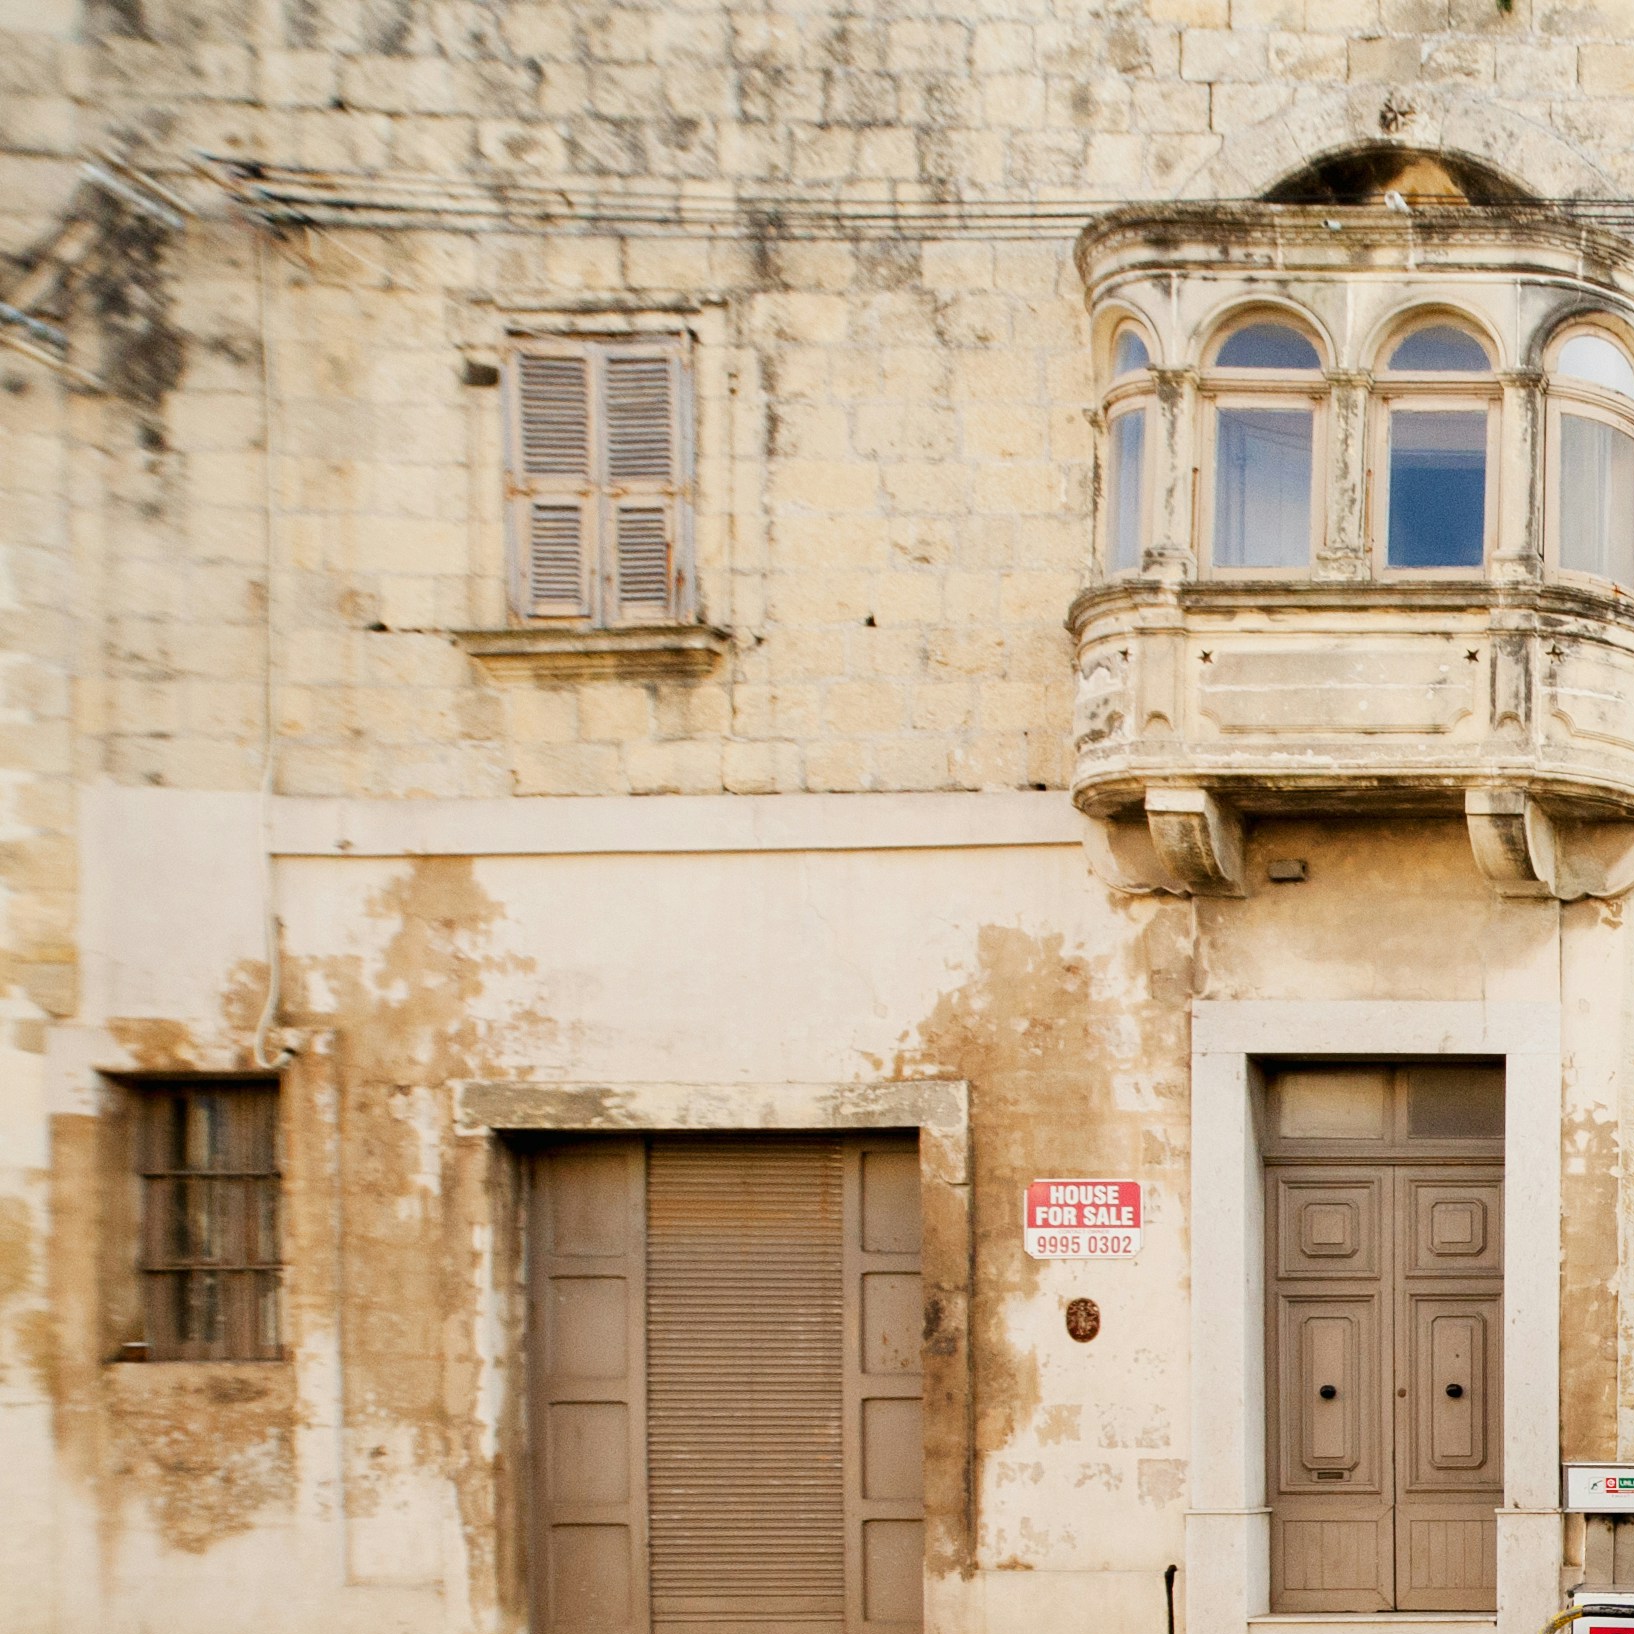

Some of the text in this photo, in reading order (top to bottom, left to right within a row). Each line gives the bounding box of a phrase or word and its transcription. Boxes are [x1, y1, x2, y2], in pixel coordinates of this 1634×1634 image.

[1049, 1185, 1119, 1205] HOUSE
[1035, 1206, 1134, 1226] FOR SALE
[1037, 1236, 1132, 1254] 9995 0302
